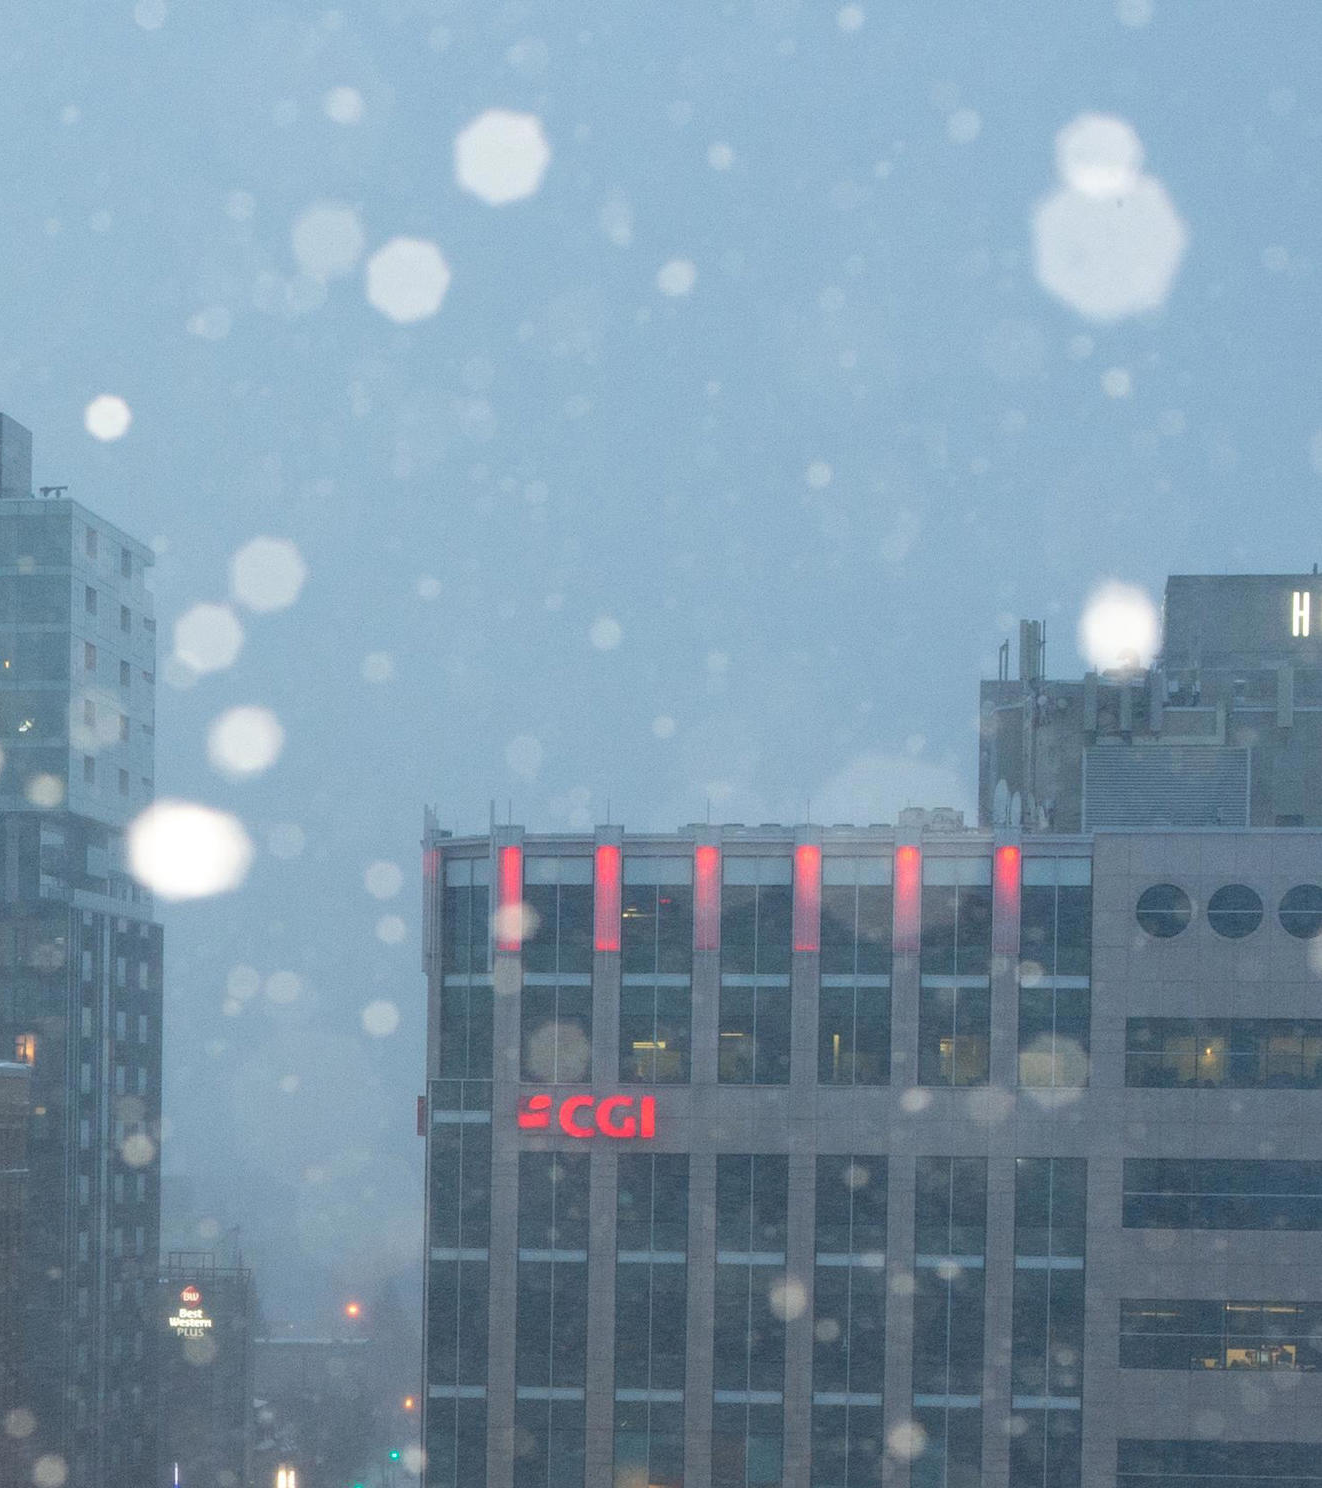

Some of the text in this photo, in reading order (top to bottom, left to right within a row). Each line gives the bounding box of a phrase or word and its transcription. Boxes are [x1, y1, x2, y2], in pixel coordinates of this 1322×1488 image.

[559, 1094, 655, 1138] CGI
[179, 1308, 203, 1319] Best
[169, 1317, 212, 1328] Western
[177, 1328, 205, 1337] PLUS
